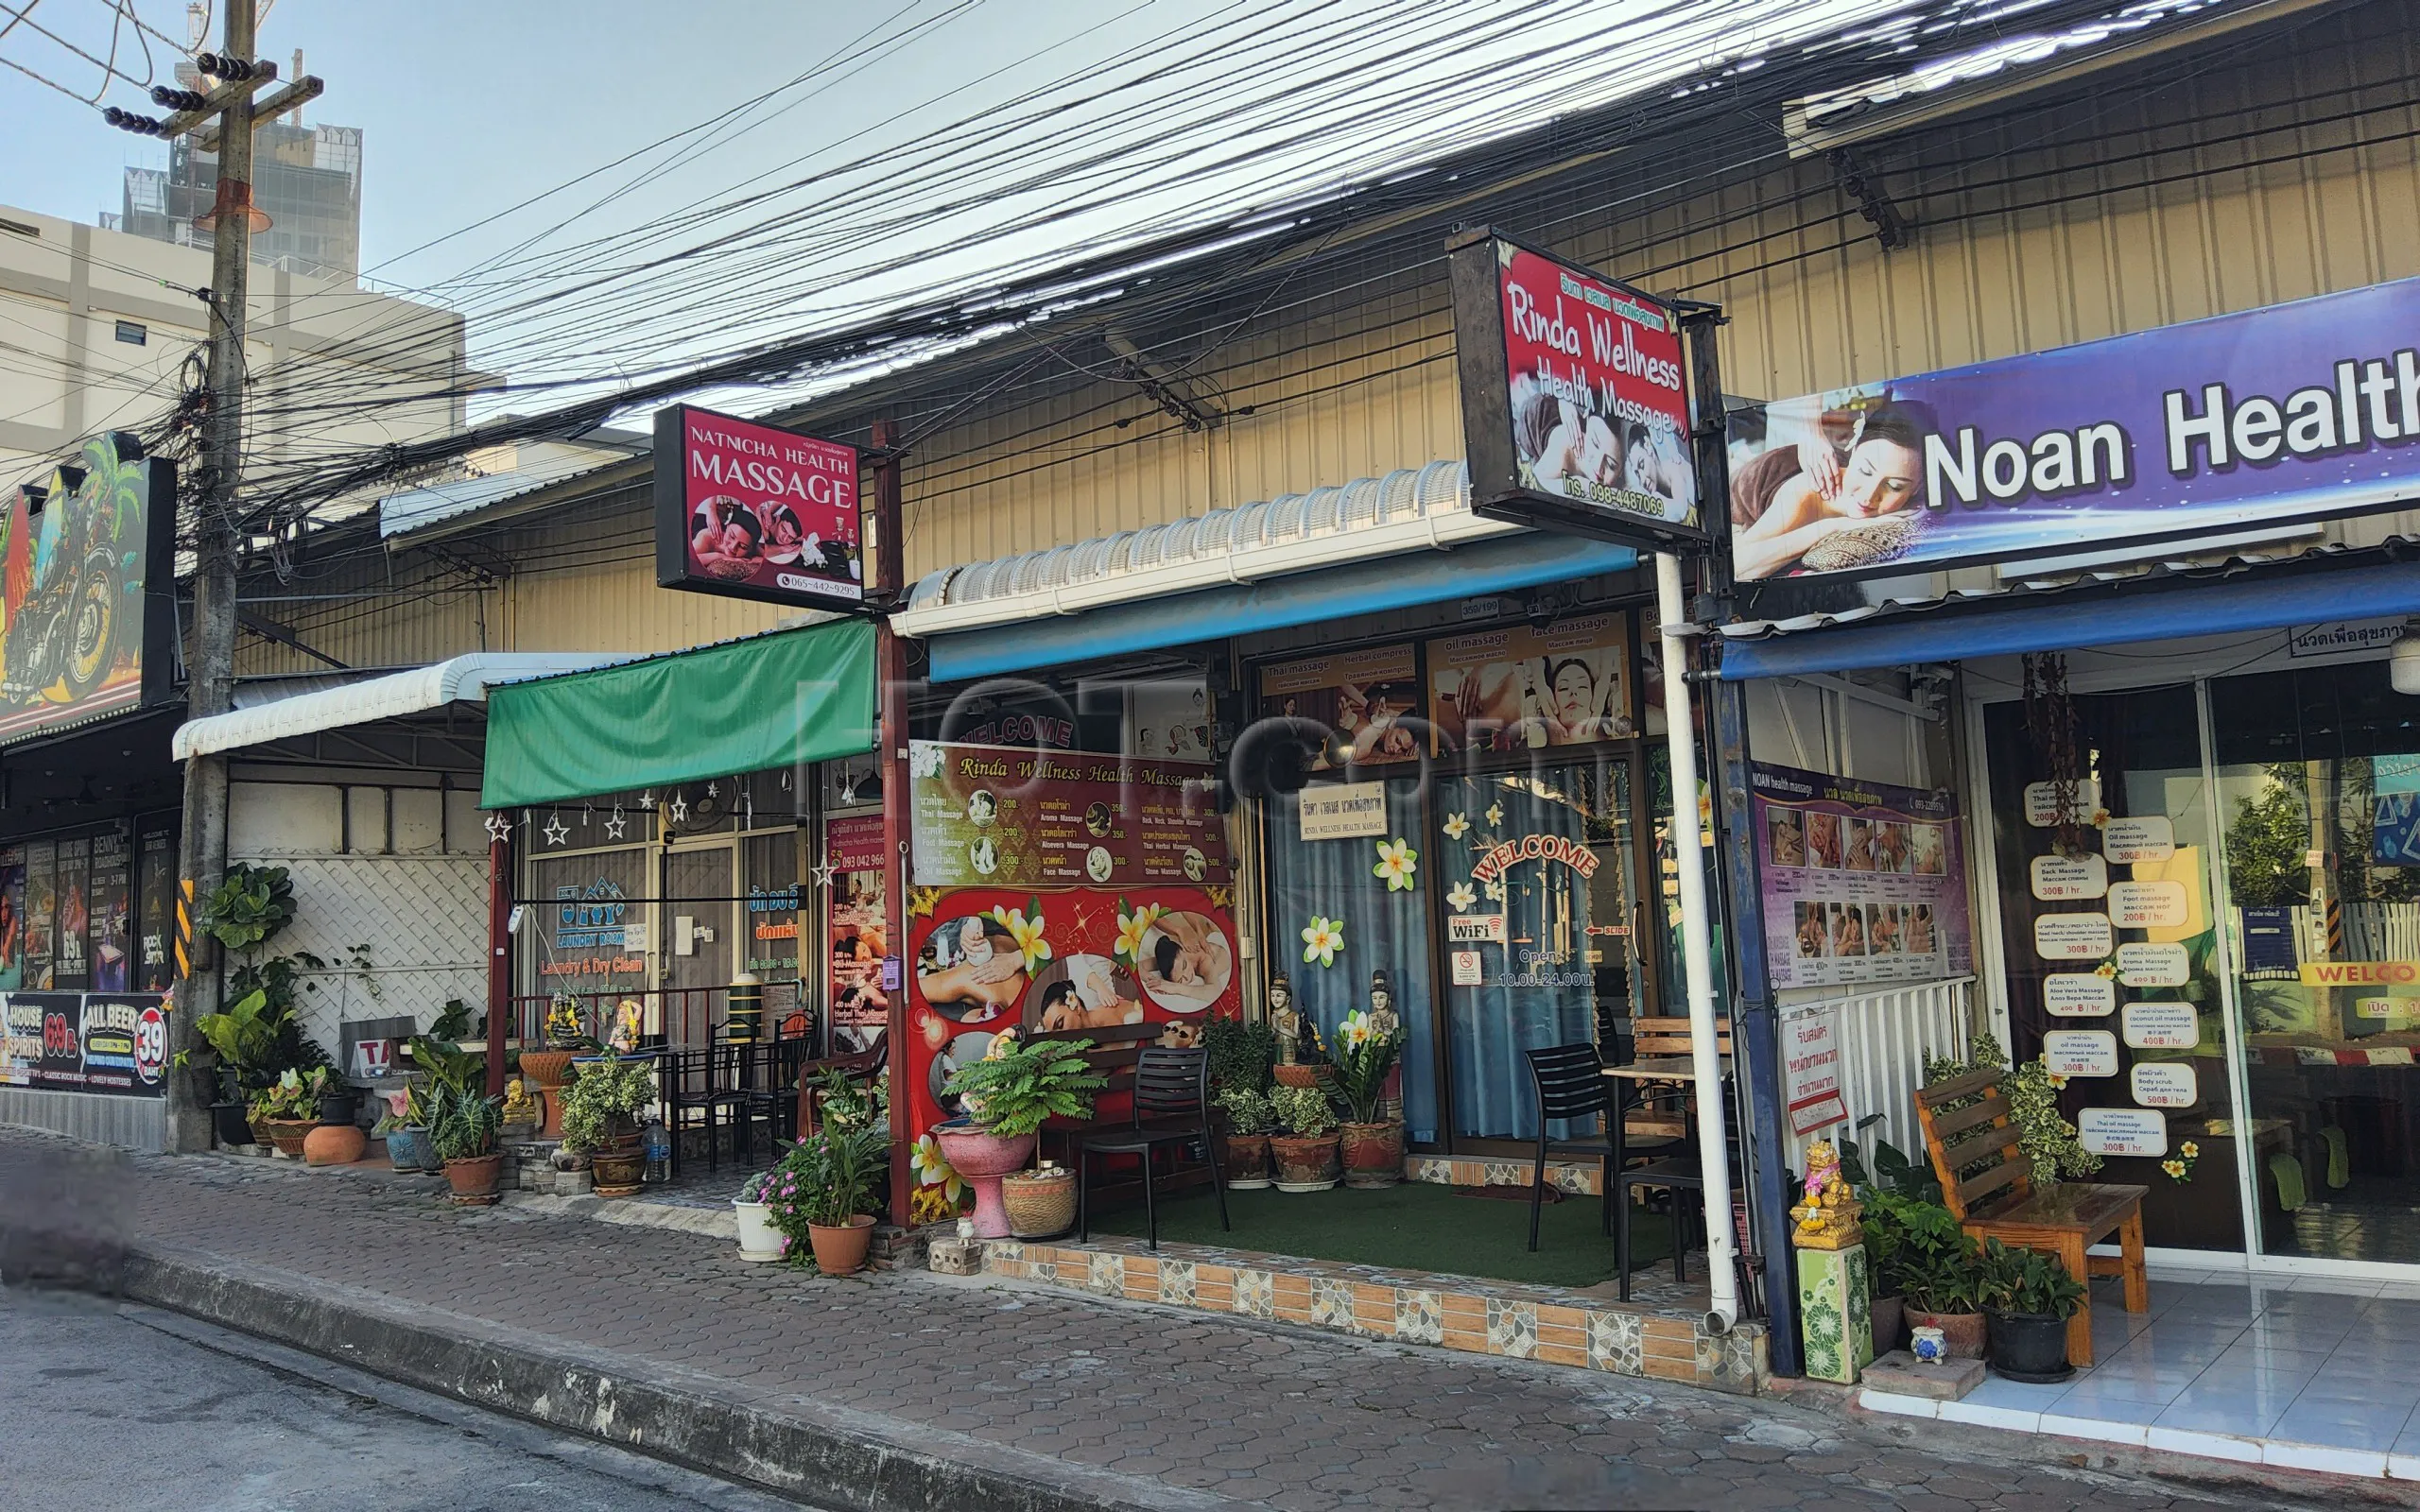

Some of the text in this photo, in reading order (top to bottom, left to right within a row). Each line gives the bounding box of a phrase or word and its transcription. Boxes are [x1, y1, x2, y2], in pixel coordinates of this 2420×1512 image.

[1507, 281, 1680, 391] Rinda Wellness
[1537, 355, 1595, 419] Health
[691, 425, 849, 475] NATNICHA HEALTH
[1923, 421, 2127, 508] Noan
[692, 449, 852, 509] MASSAGE
[1589, 482, 1665, 517] 098-4487069
[790, 577, 856, 597] 065-442-9295
[1462, 601, 1498, 615] 359/199
[1530, 617, 1608, 638] face massage
[1445, 632, 1509, 651] oil massage
[1547, 640, 1574, 649] Массаж
[1344, 647, 1412, 663] Herbal compress
[1268, 661, 1330, 677] Thai massage
[1378, 665, 1413, 675] компресс
[959, 758, 1195, 794] Rinda Wellness Health Massage
[1752, 771, 1813, 798] NOAN health massage
[921, 810, 963, 819] Thai Massage
[1040, 814, 1083, 823] Aroma Massage
[939, 839, 964, 848] Massage
[1066, 841, 1090, 850] Massage
[1471, 833, 1600, 884] WELCOME
[1059, 868, 1081, 877] Massage
[2058, 868, 2085, 876] Massage
[556, 933, 598, 949] LAUNDRY
[598, 931, 625, 946] ROOM
[1453, 925, 1490, 938] WiFi
[541, 956, 643, 977] Laundry & Dry Clean
[2316, 964, 2416, 983] WELCO
[9, 1005, 43, 1028] HOUSE
[87, 1004, 137, 1032] ALL BEER
[9, 1036, 43, 1060] SPIRITS
[138, 1021, 164, 1062] 39
[144, 1066, 159, 1077] BAHT
